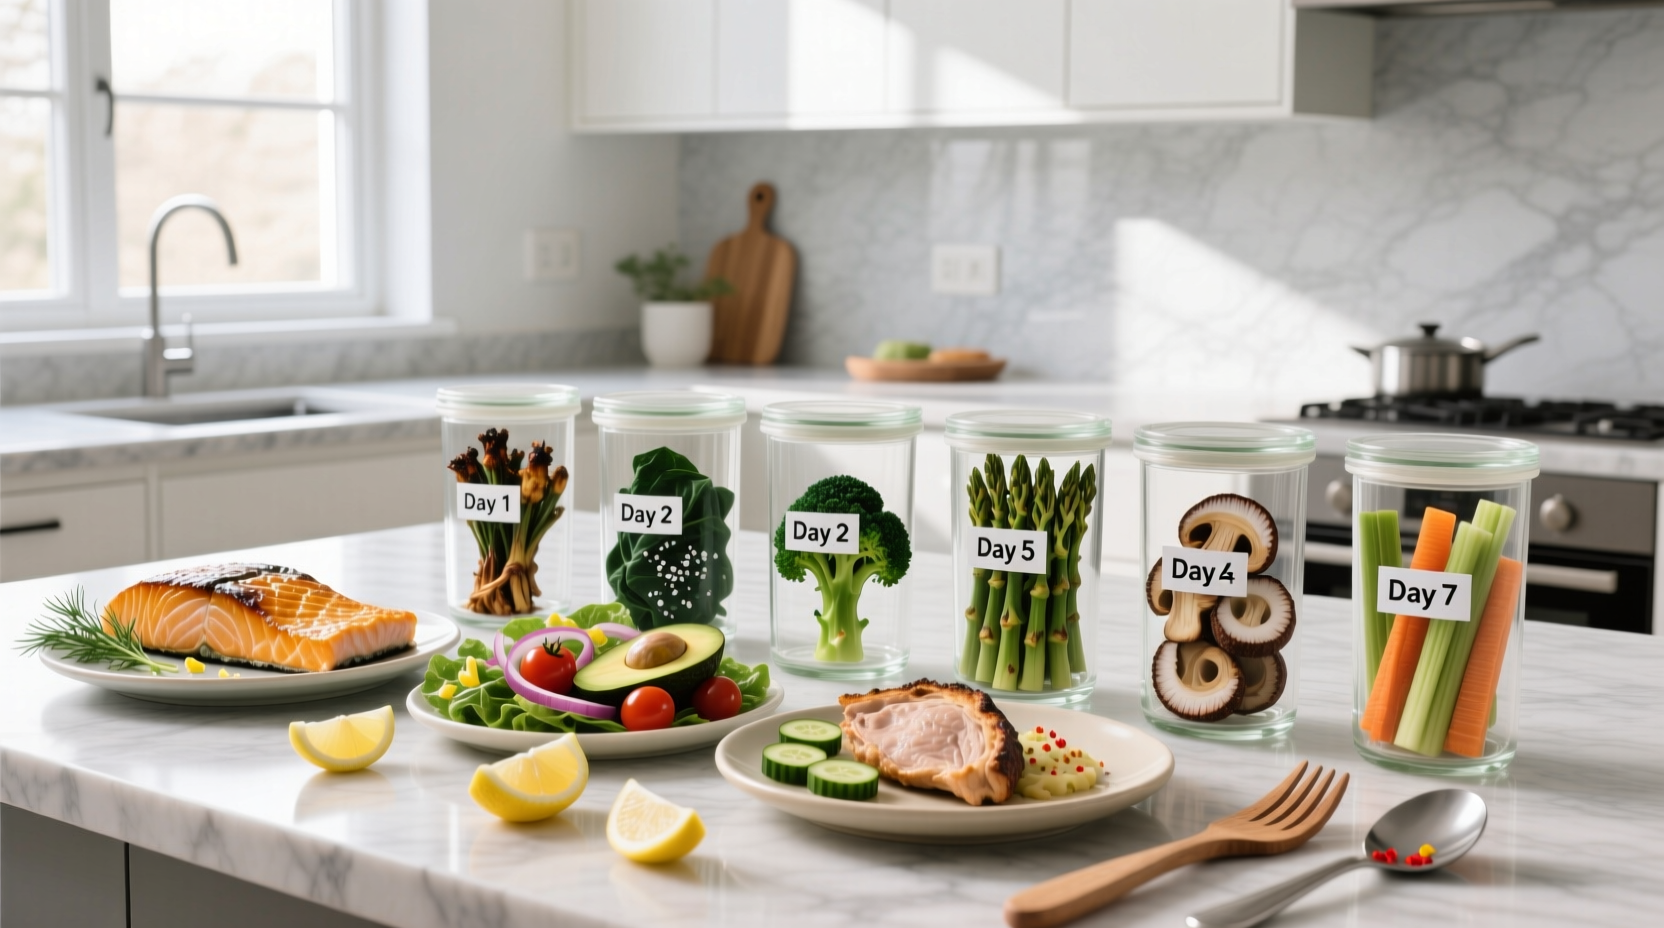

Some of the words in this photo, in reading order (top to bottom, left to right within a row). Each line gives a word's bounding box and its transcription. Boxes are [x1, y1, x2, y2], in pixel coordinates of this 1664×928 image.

[463, 492, 496, 516] Day
[502, 494, 509, 512] 1
[621, 502, 657, 529] Day
[660, 505, 673, 524] 2
[793, 520, 832, 548] Day
[836, 522, 849, 543] 2
[977, 536, 1017, 566] Day
[1021, 539, 1035, 562] 5
[1171, 557, 1216, 588] Day
[1218, 562, 1236, 585] 4
[1388, 578, 1437, 611] Day
[1441, 583, 1458, 606] 7
